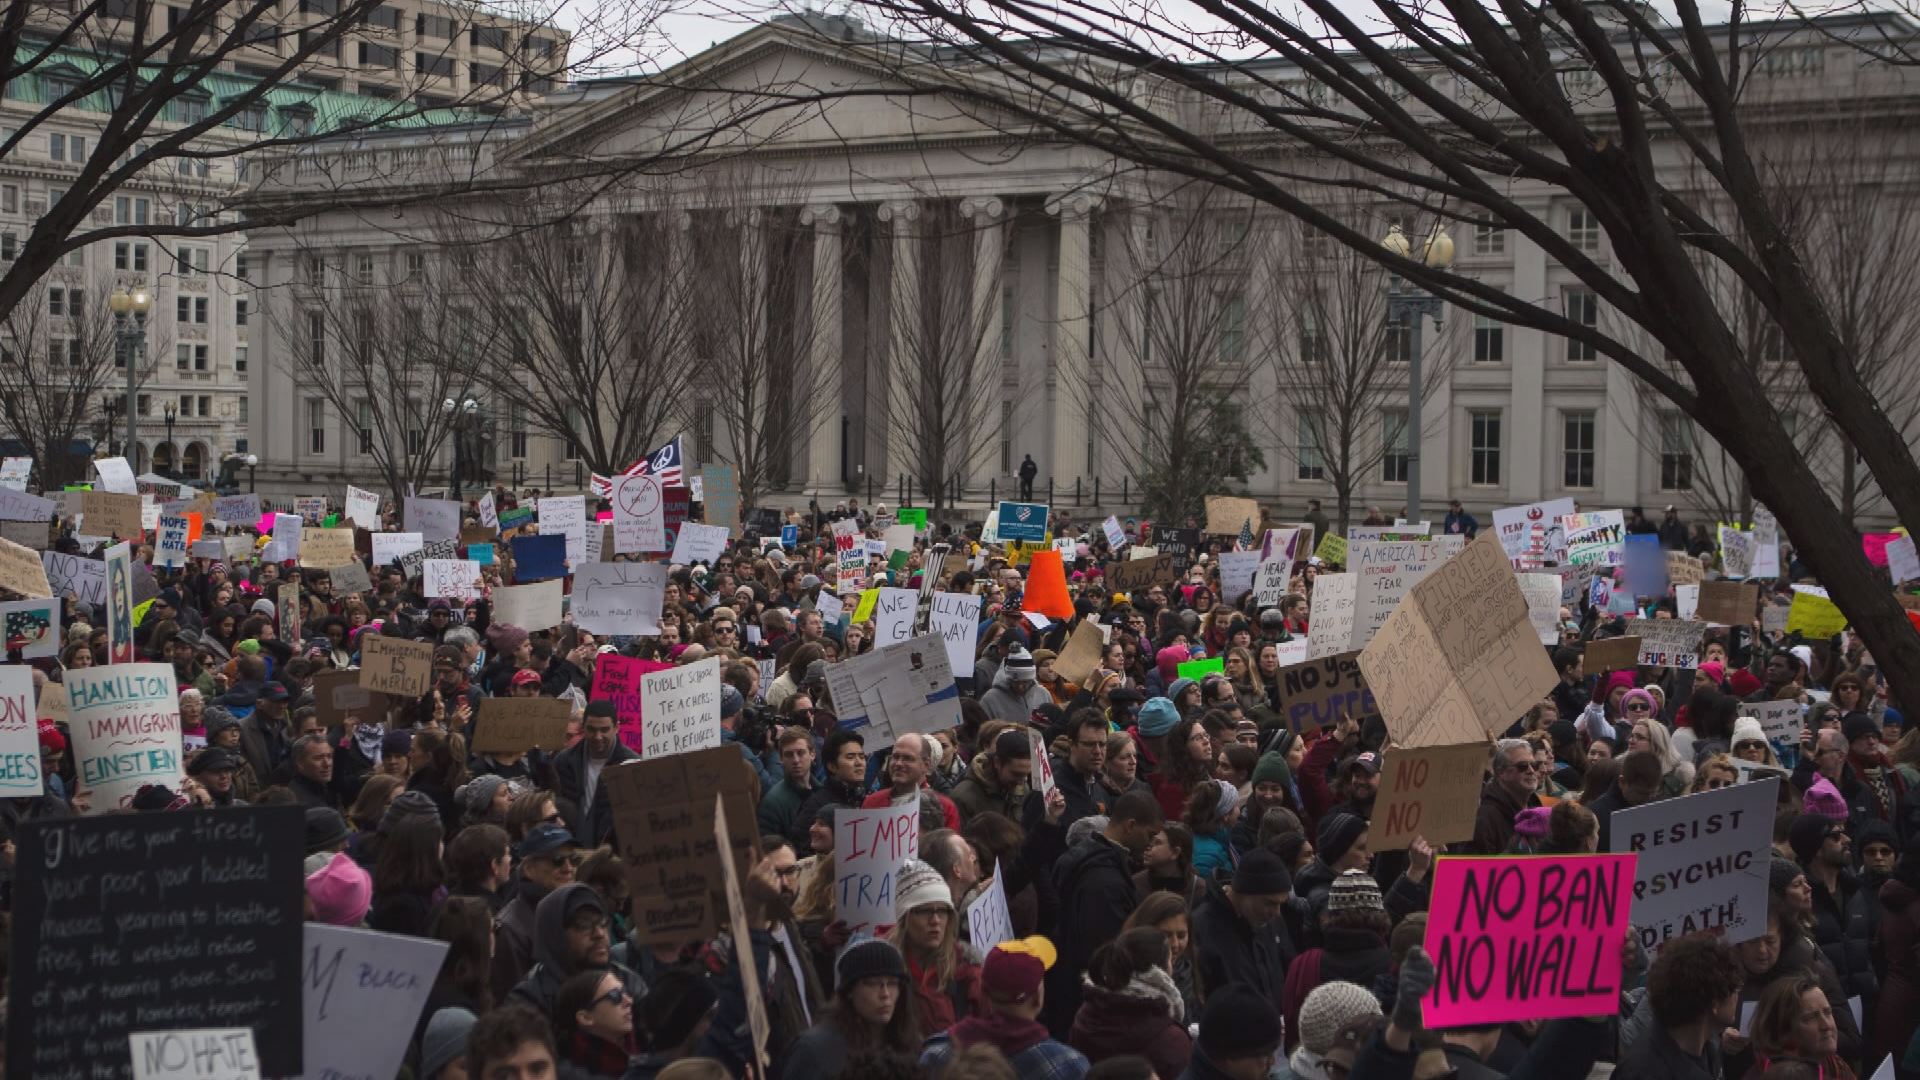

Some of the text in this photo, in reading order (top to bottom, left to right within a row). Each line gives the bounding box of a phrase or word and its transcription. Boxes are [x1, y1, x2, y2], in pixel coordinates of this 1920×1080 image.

[160, 516, 188, 530] HOPE
[161, 541, 187, 552] HATE
[165, 531, 182, 542] NOT
[836, 535, 853, 551] NO
[1161, 530, 1178, 541] WE
[50, 553, 78, 578] NO
[401, 539, 454, 568] REFUGEES
[840, 548, 864, 562] RACISM
[841, 559, 865, 570] SEXISM
[1361, 545, 1416, 566] AMERICA
[1419, 544, 1439, 562] IS
[432, 562, 449, 574] NO
[452, 562, 472, 575] BAN
[432, 575, 448, 586] NO
[1264, 562, 1286, 576] HEAR
[1365, 565, 1397, 575] STRONGER
[1266, 577, 1282, 588] OUR
[1315, 578, 1344, 598] WHO
[881, 597, 907, 614] WE
[955, 601, 980, 620] NOT
[1255, 590, 1285, 605] VOICE
[1315, 599, 1355, 613] BE NEX
[1313, 617, 1335, 632] AND
[368, 638, 432, 662] IMMIGRATION
[1311, 633, 1337, 647] WILL
[391, 656, 406, 674] IS
[69, 675, 169, 707] HAMILTON
[370, 672, 425, 698] AMERICA!
[647, 667, 713, 695] PUBLIC SCHOOL
[1286, 667, 1321, 697] NO
[658, 692, 714, 716] TEACHERS:
[1290, 689, 1376, 735] PUPPE
[88, 712, 181, 740] IMMIGRANT
[683, 716, 697, 727] US
[699, 712, 713, 724] ALL
[648, 728, 715, 756] THE REFUGEES
[1393, 758, 1429, 793] NO
[1384, 800, 1421, 838] NO
[1630, 809, 1744, 852] RESIST
[104, 814, 264, 859] me your tired,
[844, 811, 918, 863] IMPE
[43, 875, 89, 914] your
[155, 866, 192, 900] your
[201, 853, 268, 884] huddled
[1633, 850, 1753, 901] PSYCHIC
[839, 872, 889, 908] TRA
[1455, 861, 1620, 932] NO BAN
[115, 905, 188, 946] yearning
[192, 909, 209, 923] to
[215, 902, 281, 928] breathe
[972, 892, 1004, 949] REFU
[89, 944, 121, 967] the
[358, 962, 419, 990] BLACK
[1433, 934, 1614, 1009] NO WALL
[145, 1032, 256, 1076] NO HATE
